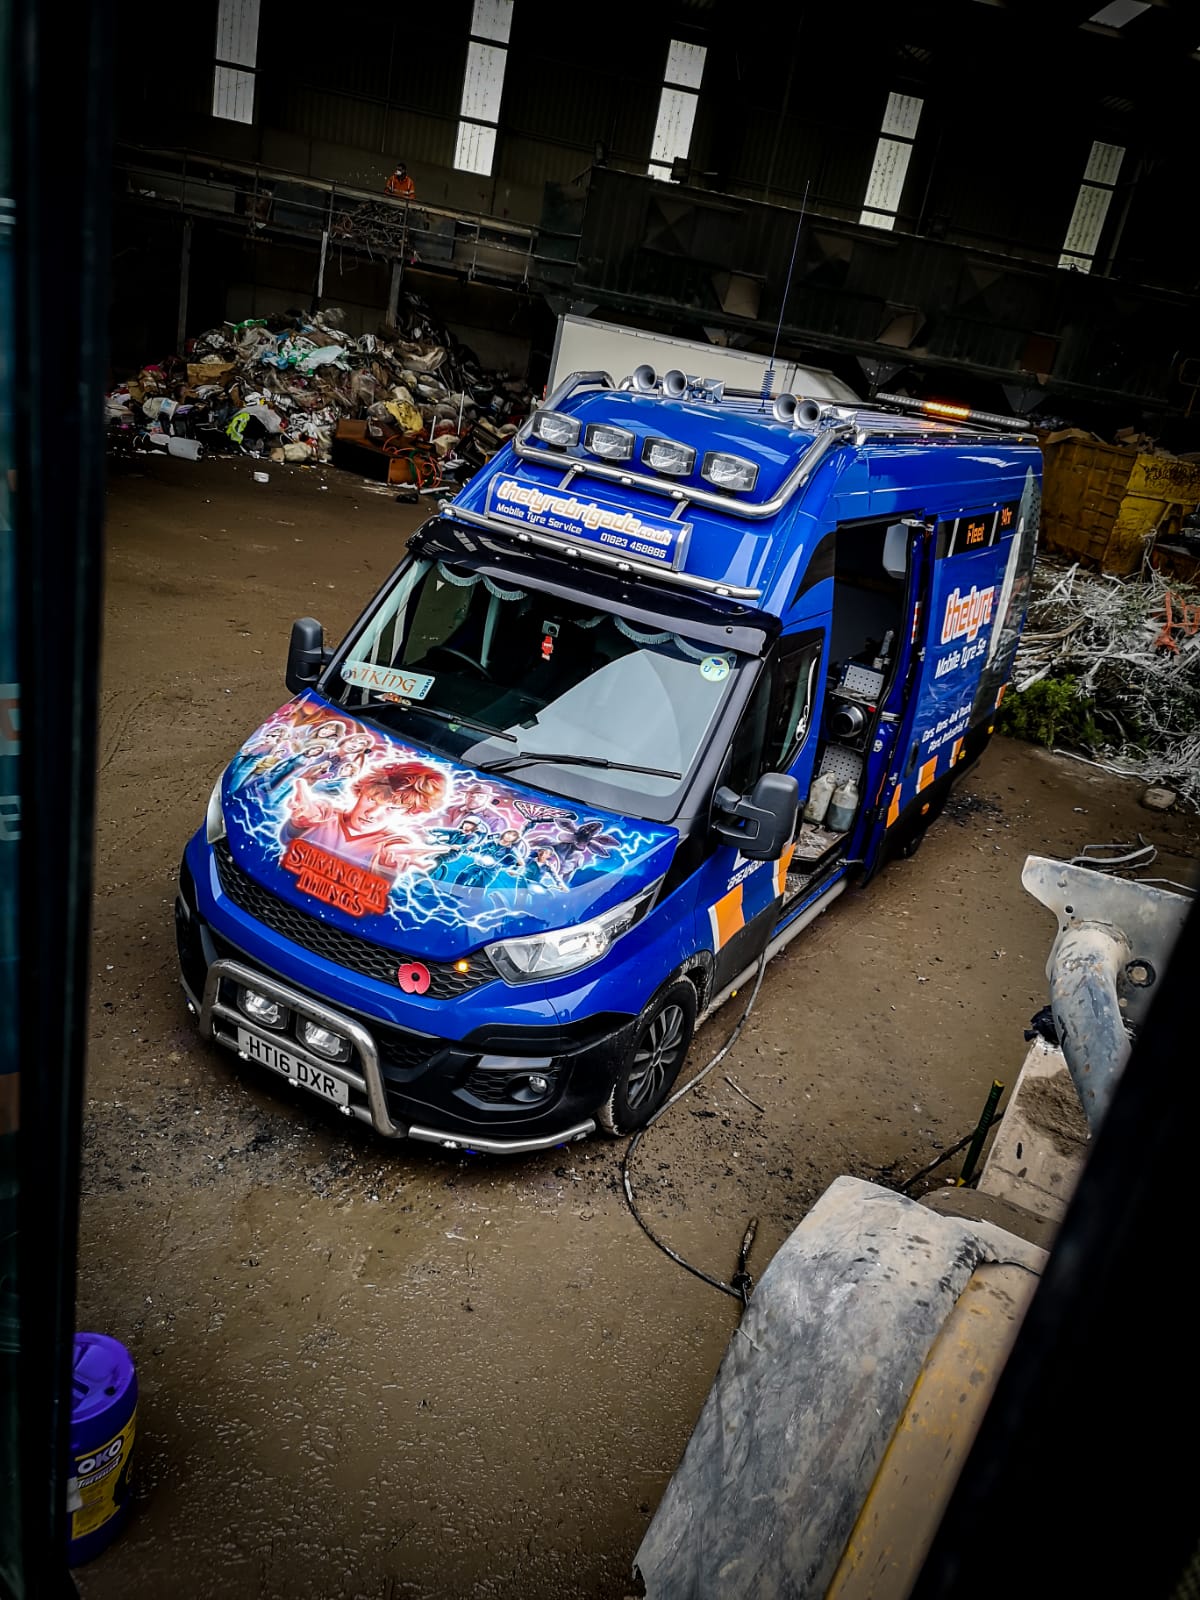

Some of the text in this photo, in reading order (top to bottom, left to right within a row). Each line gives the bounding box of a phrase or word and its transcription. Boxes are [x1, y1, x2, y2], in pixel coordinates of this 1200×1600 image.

[496, 503, 583, 535] Mobile Tyre Service
[418, 678, 432, 697] IVECO
[288, 842, 386, 905] STRANGER
[299, 871, 364, 914] THINGS
[249, 1036, 335, 1097] HT16 DXR
[77, 1439, 122, 1474] OKO
